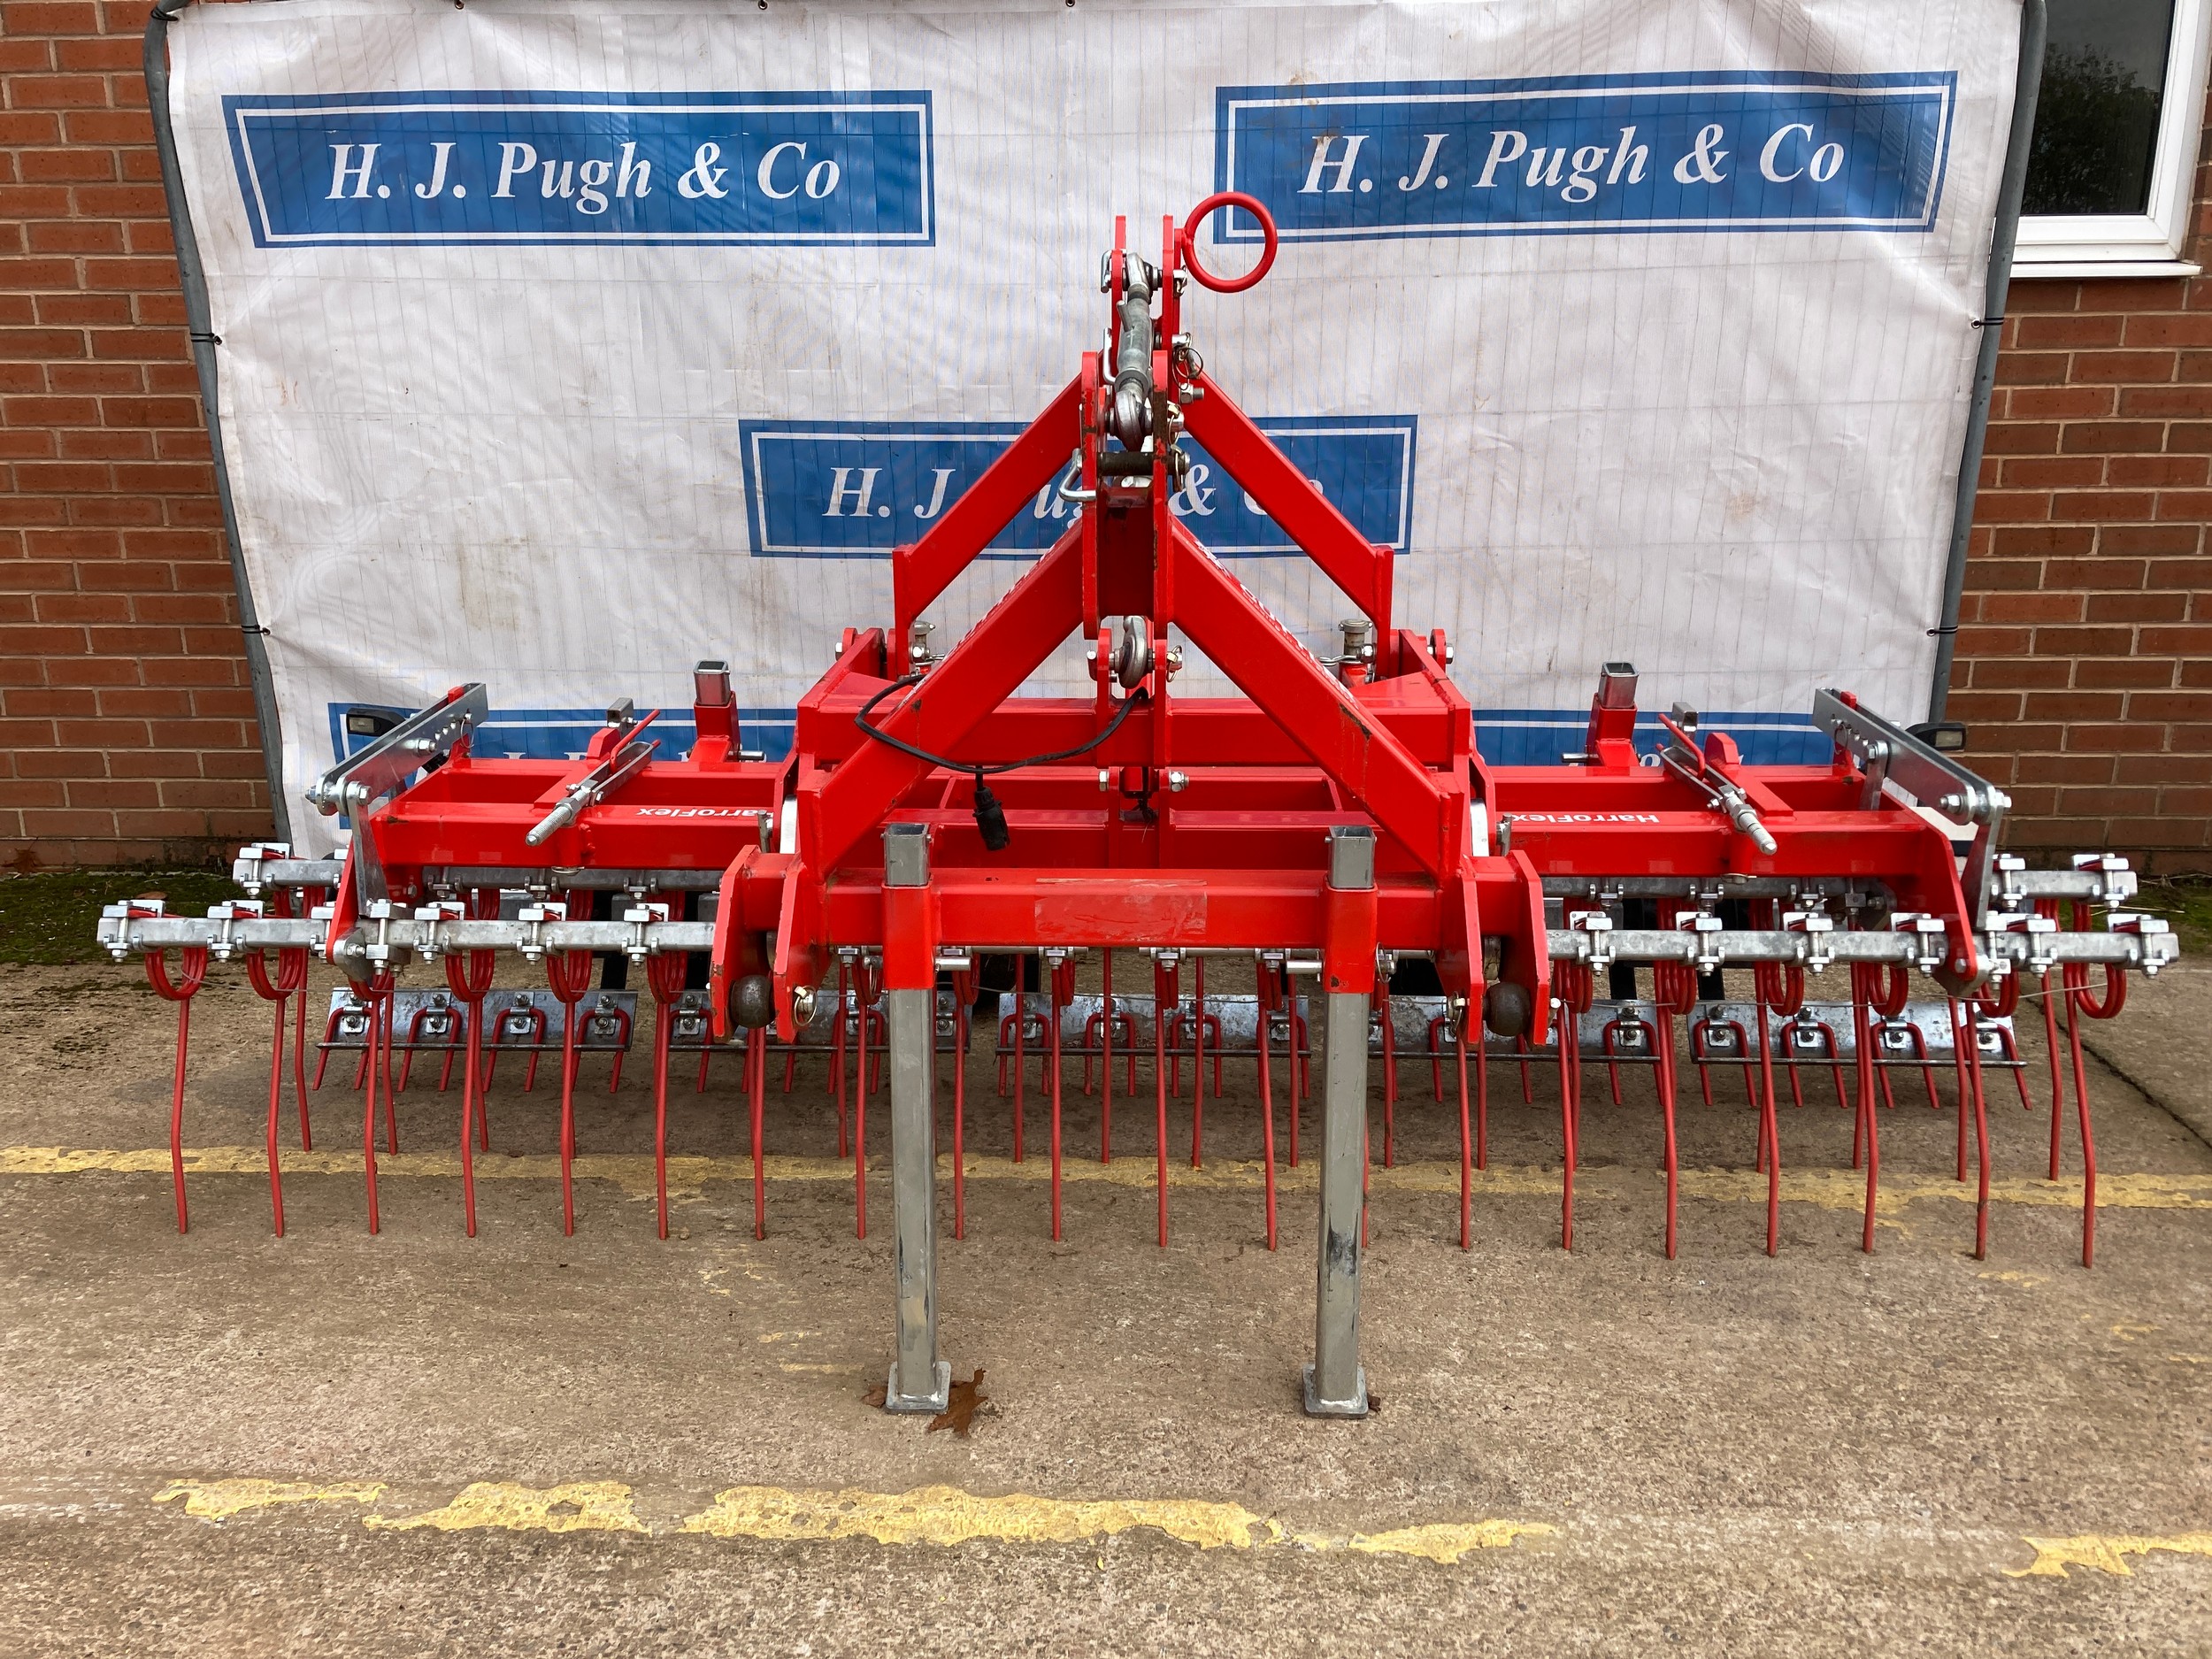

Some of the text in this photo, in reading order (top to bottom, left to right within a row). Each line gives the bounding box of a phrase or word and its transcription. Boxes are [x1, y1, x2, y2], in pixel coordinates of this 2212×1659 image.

[324, 142, 841, 214] H. J. Pugh & Co
[1297, 123, 1846, 204] H. J. Pugh & Co
[822, 467, 891, 518] H.
[914, 468, 956, 518] J
[1511, 814, 1660, 824] HarroFlex
